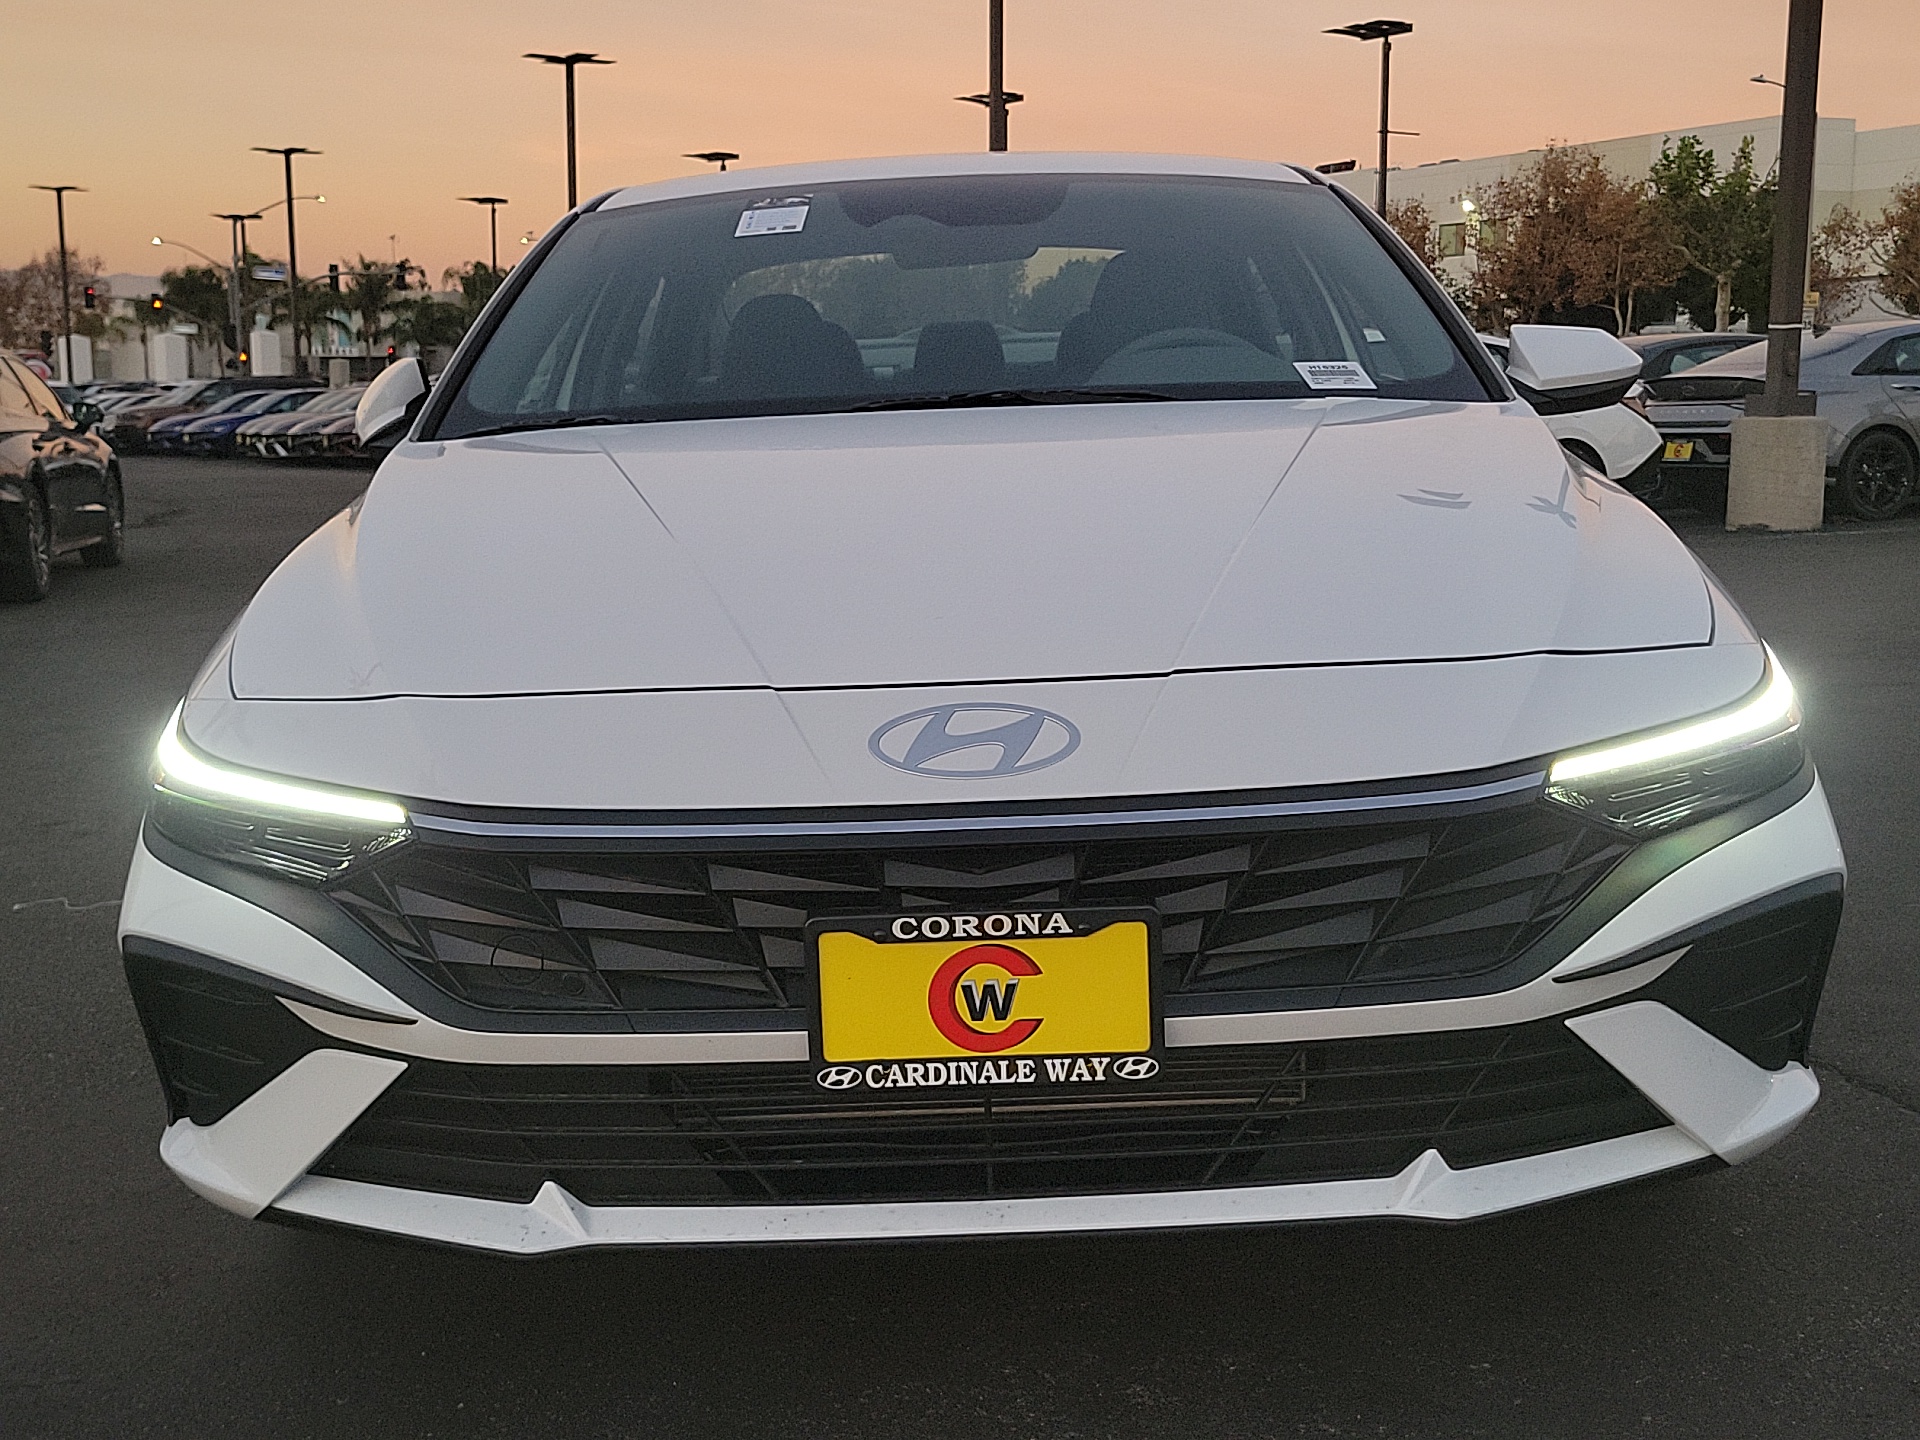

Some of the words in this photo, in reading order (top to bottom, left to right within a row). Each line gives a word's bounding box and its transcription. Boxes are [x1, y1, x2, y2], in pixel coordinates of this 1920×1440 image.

[891, 912, 1073, 939] CORONA
[865, 1058, 1036, 1089] CARDINALE
[1044, 1056, 1111, 1083] WAY
